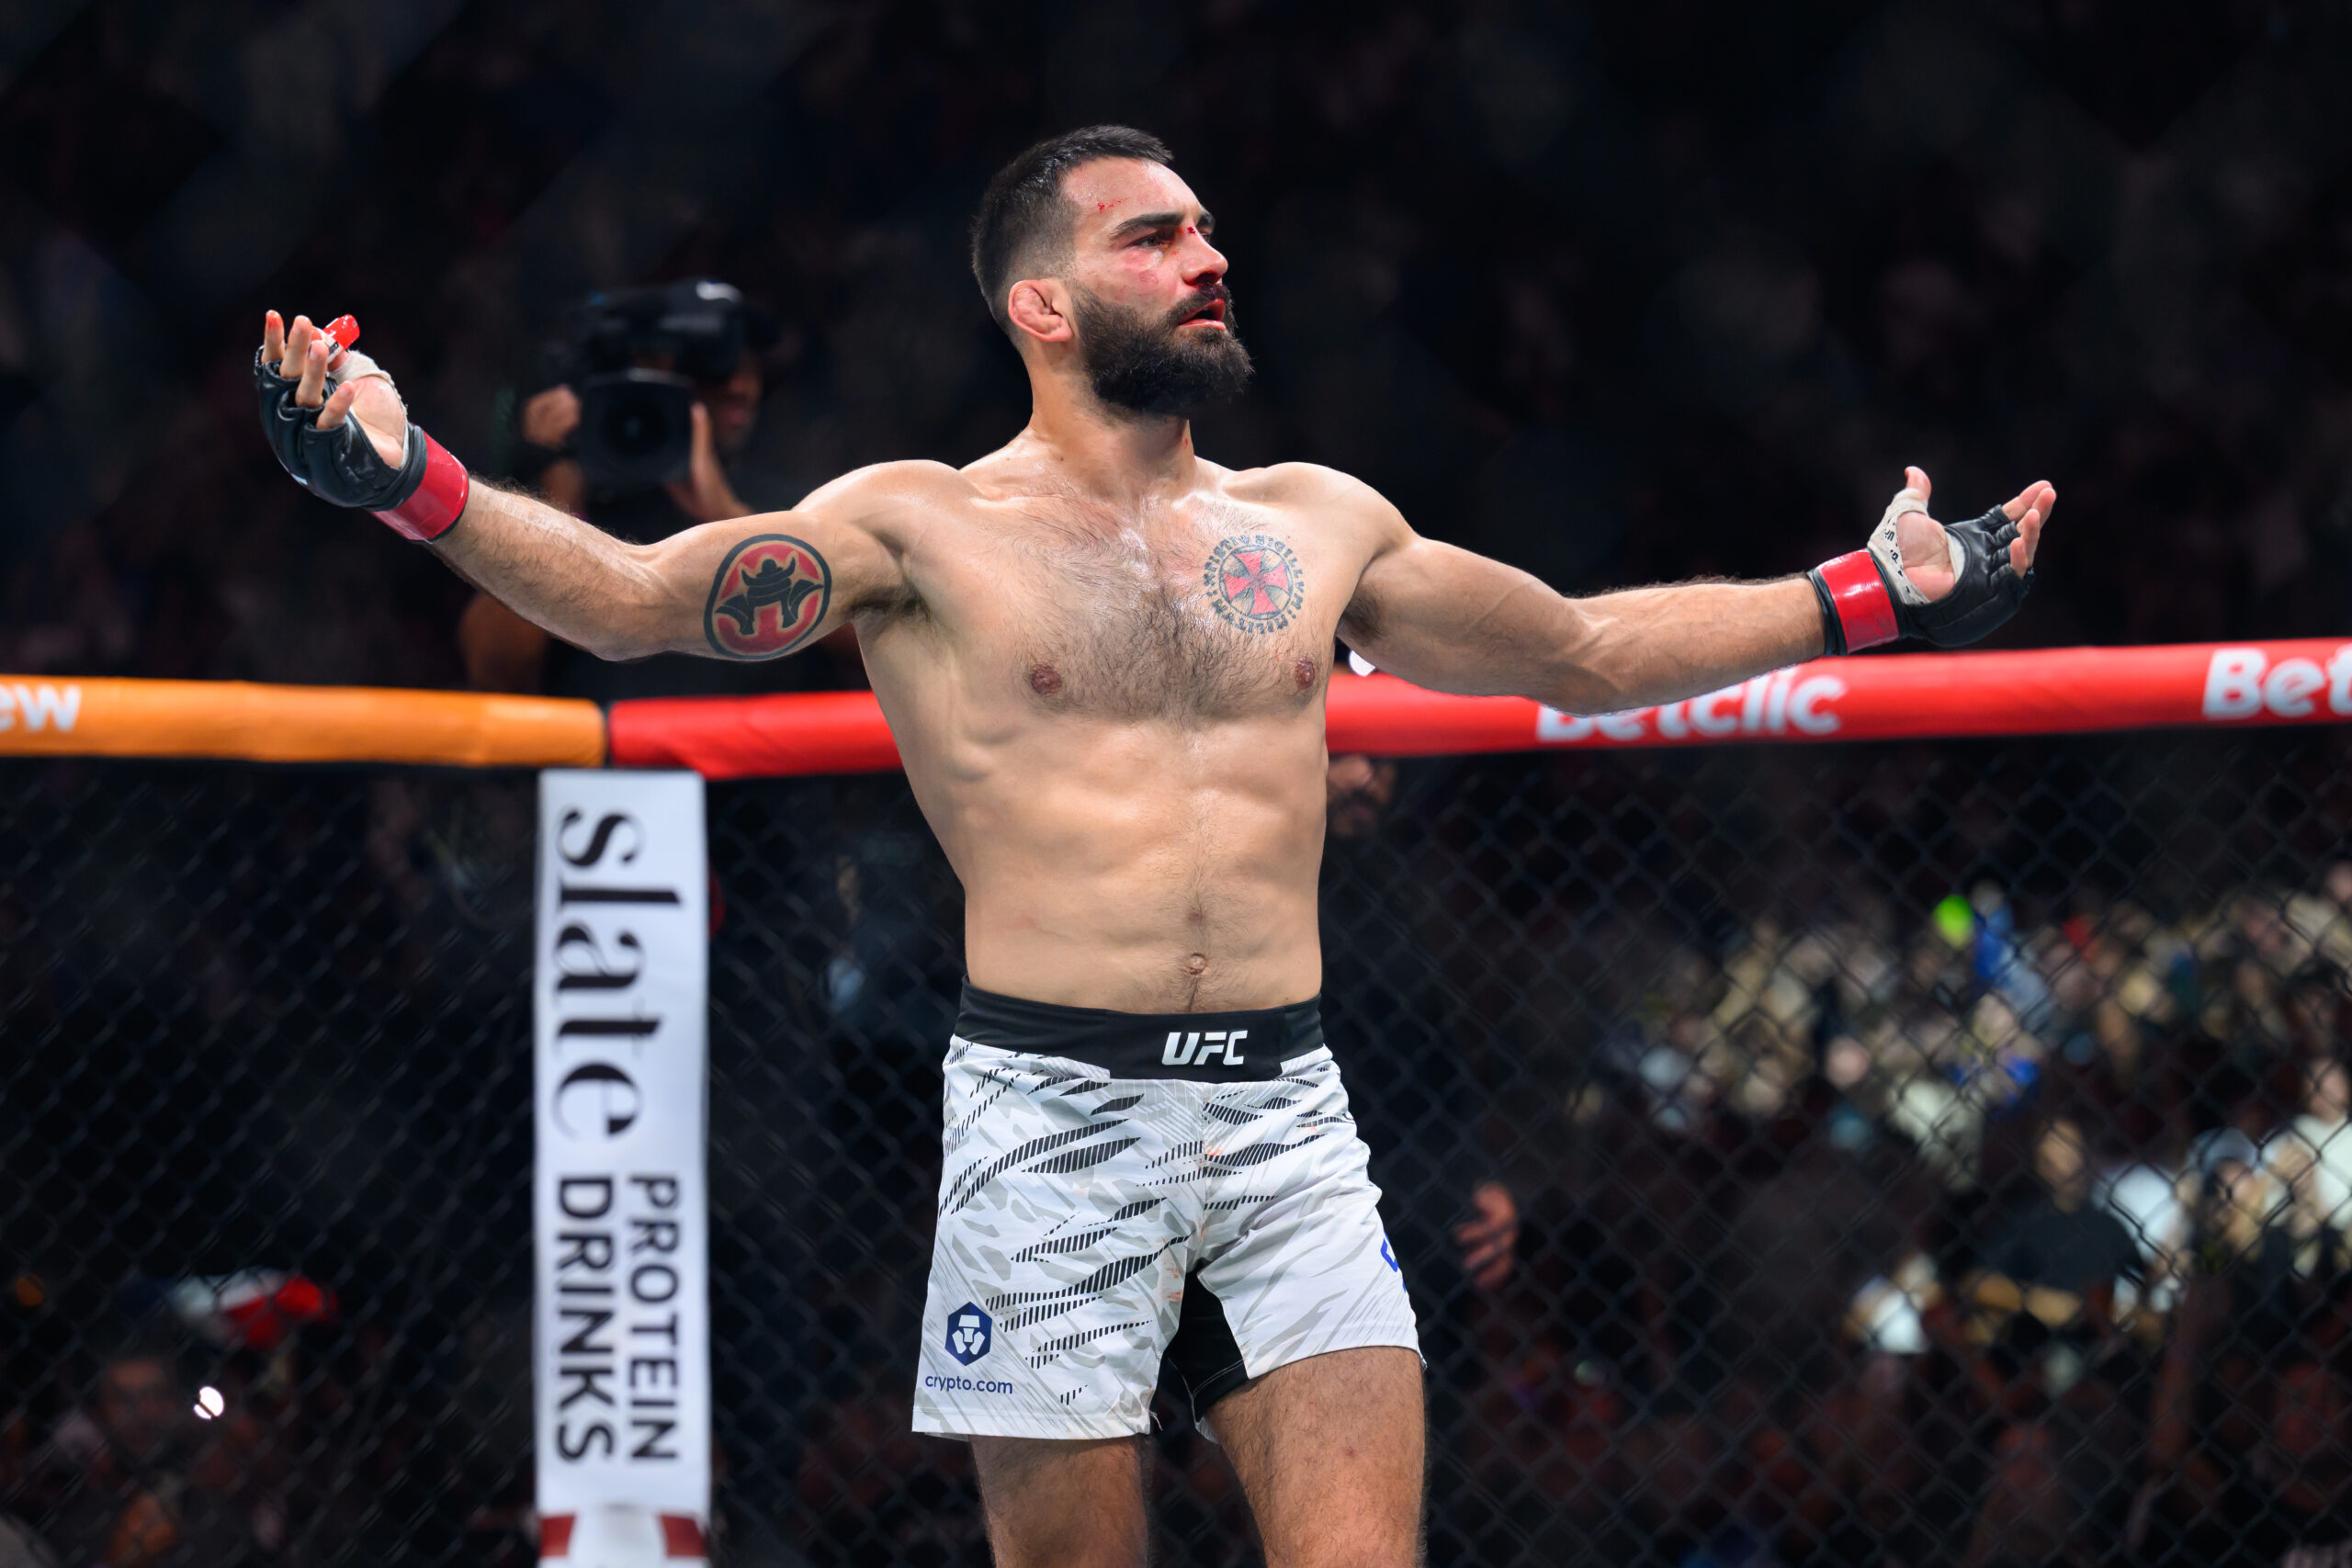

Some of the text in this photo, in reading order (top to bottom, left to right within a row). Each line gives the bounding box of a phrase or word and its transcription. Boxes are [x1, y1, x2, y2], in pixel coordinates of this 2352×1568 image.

[2201, 643, 2352, 719] Bet
[555, 803, 684, 1141] slate
[1161, 1030, 1249, 1066] UFC
[557, 1177, 615, 1461] DRINKS
[629, 1175, 680, 1461] PROTEIN
[924, 1375, 1013, 1394] crypto.com
